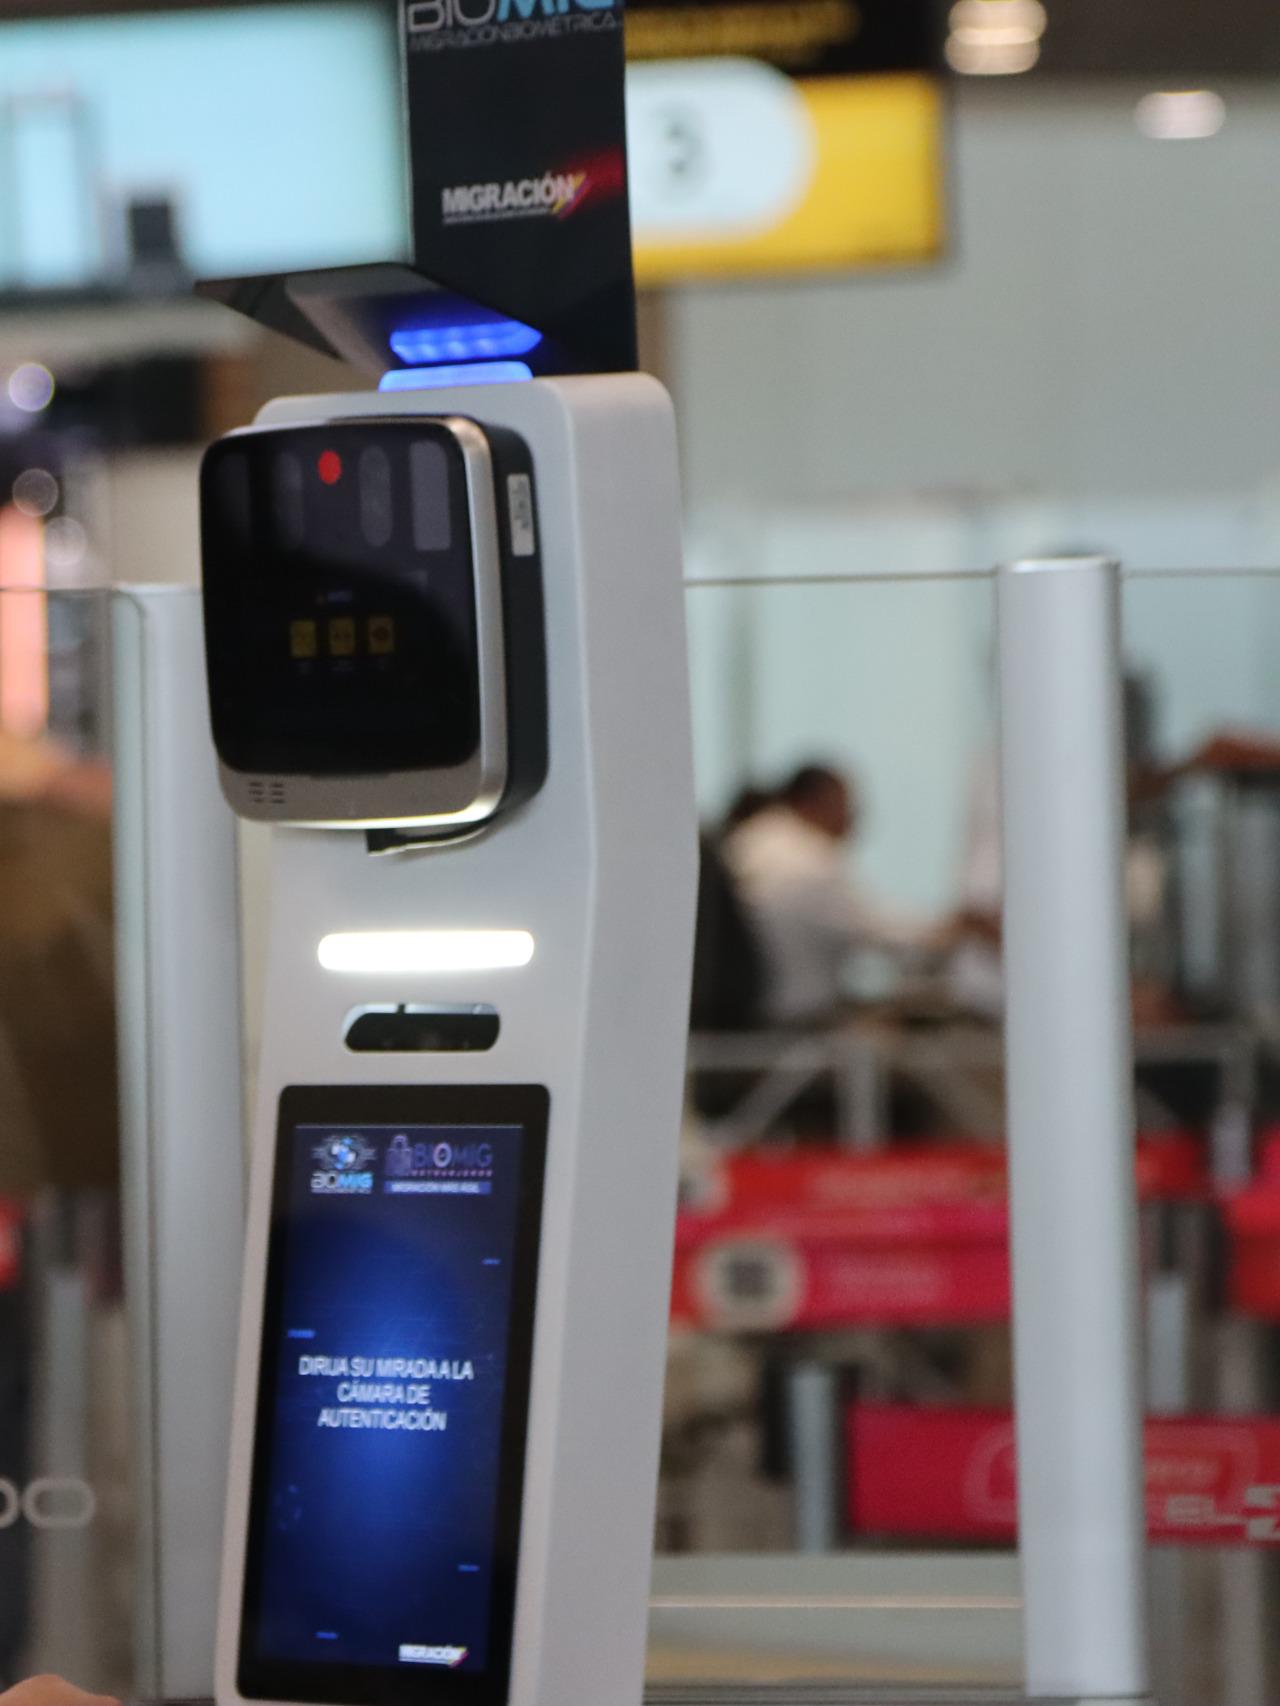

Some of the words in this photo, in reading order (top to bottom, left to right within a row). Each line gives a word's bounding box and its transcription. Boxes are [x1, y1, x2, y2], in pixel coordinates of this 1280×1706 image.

[350, 1356, 374, 1377] SU
[376, 1357, 438, 1379] MIRADA
[452, 1360, 474, 1380] LA
[336, 1380, 405, 1403] CÁMARA
[406, 1383, 431, 1404] DE
[317, 1407, 448, 1431] AUTENTICACIÓN
